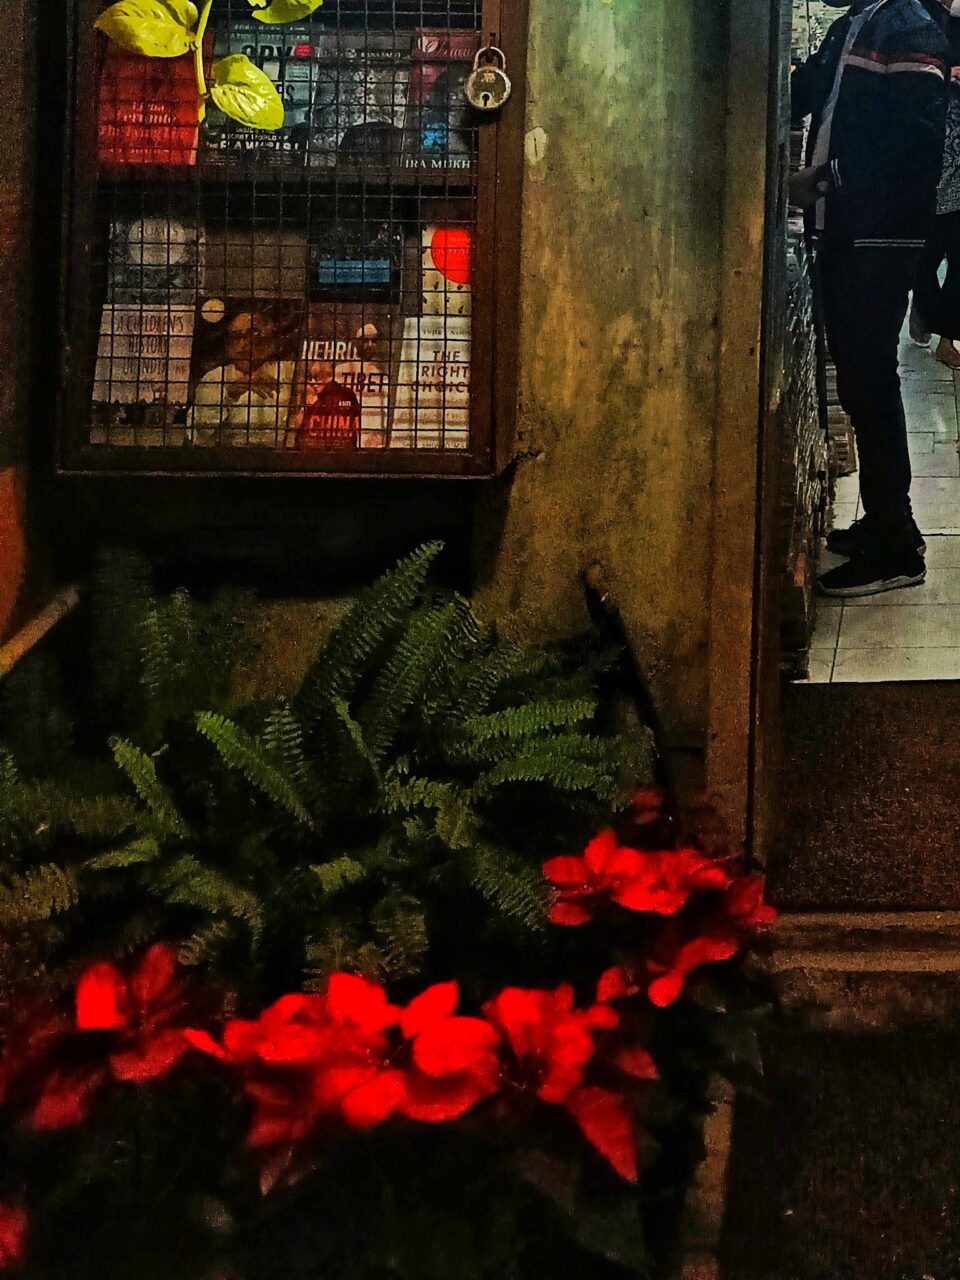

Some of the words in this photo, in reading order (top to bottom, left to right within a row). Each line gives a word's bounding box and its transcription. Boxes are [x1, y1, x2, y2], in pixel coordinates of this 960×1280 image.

[405, 159, 427, 169] IRA
[431, 159, 470, 169] MUKH
[432, 351, 461, 362] THE
[421, 365, 470, 379] RIGHT
[341, 372, 388, 393] TIBET
[411, 381, 470, 394] CHOIC
